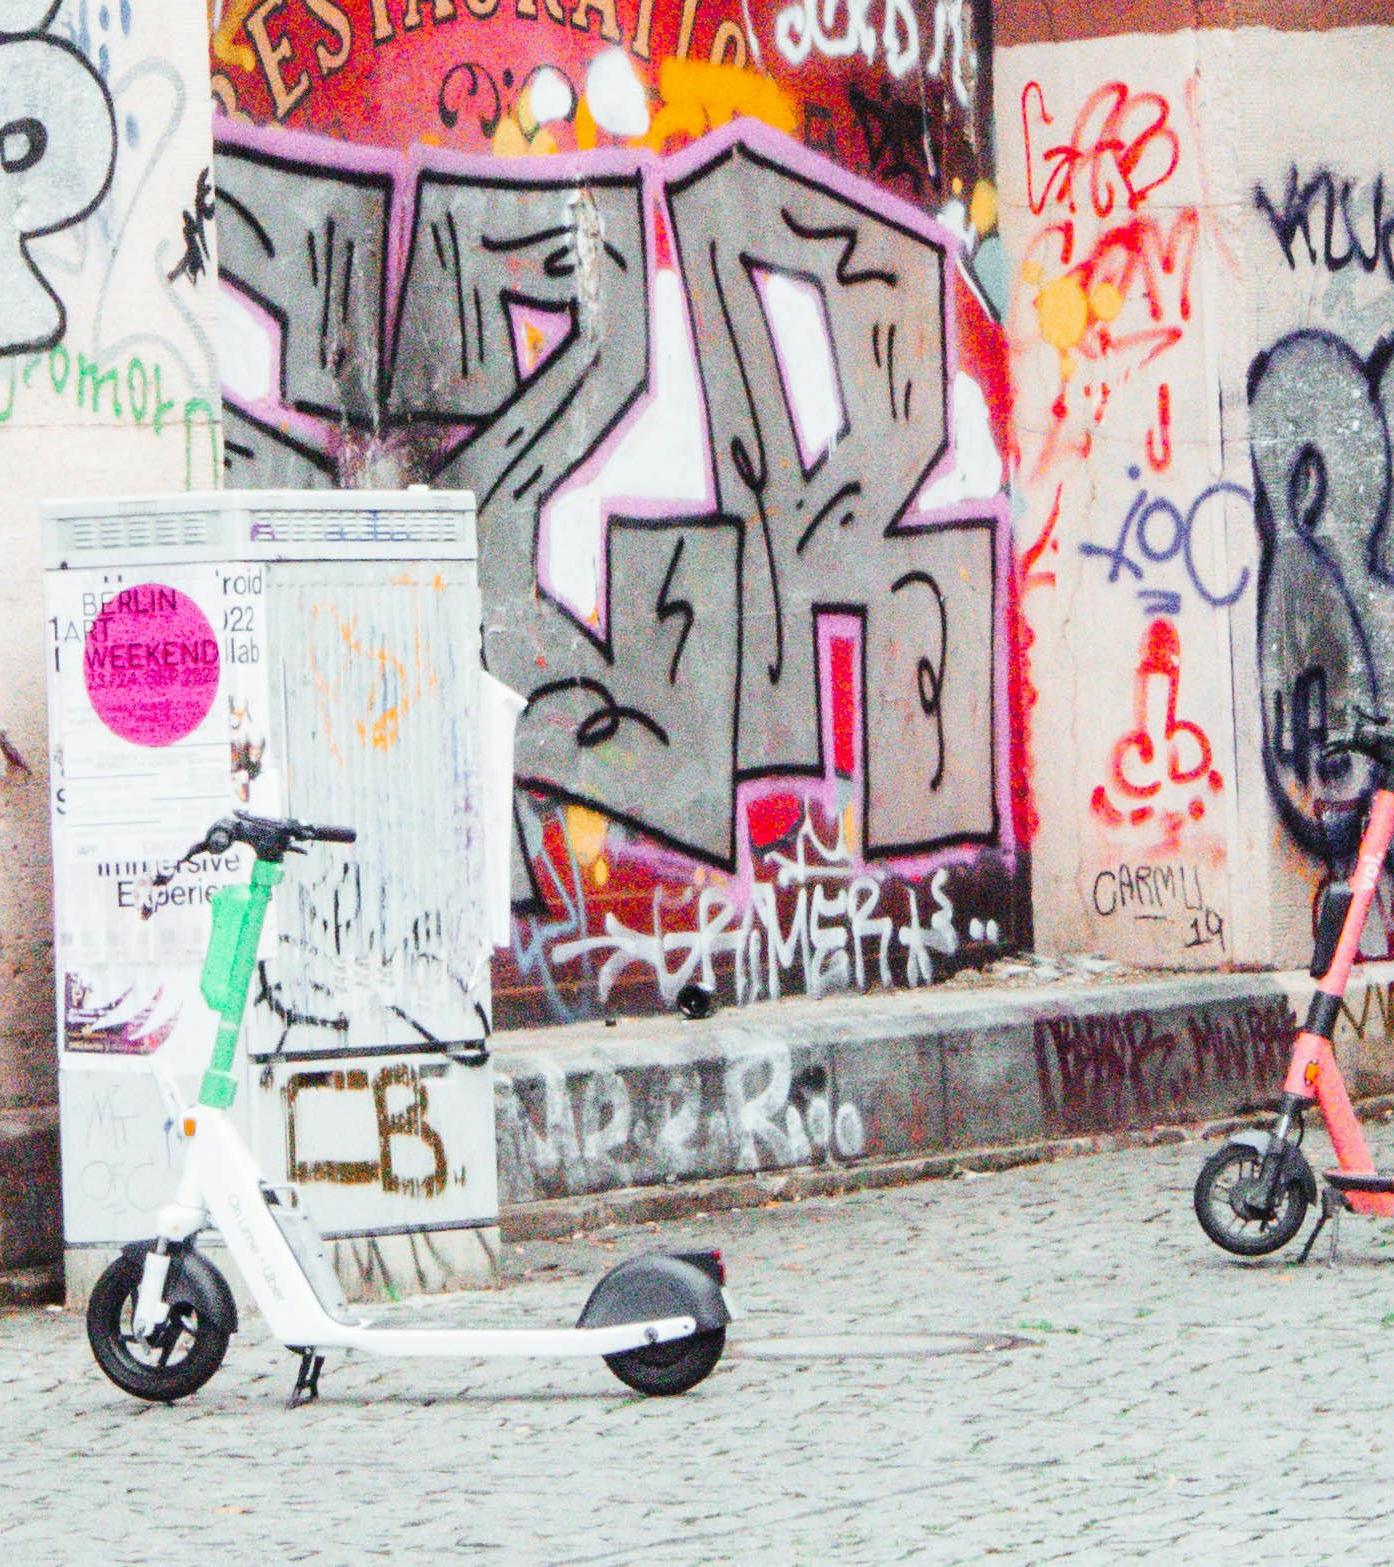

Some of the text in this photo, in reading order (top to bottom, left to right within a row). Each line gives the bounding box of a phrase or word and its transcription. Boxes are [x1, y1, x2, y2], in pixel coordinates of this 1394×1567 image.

[215, 563, 263, 596] roid
[82, 588, 178, 617] BERLIN
[64, 616, 115, 643] ART
[84, 638, 220, 670] WEEKEND
